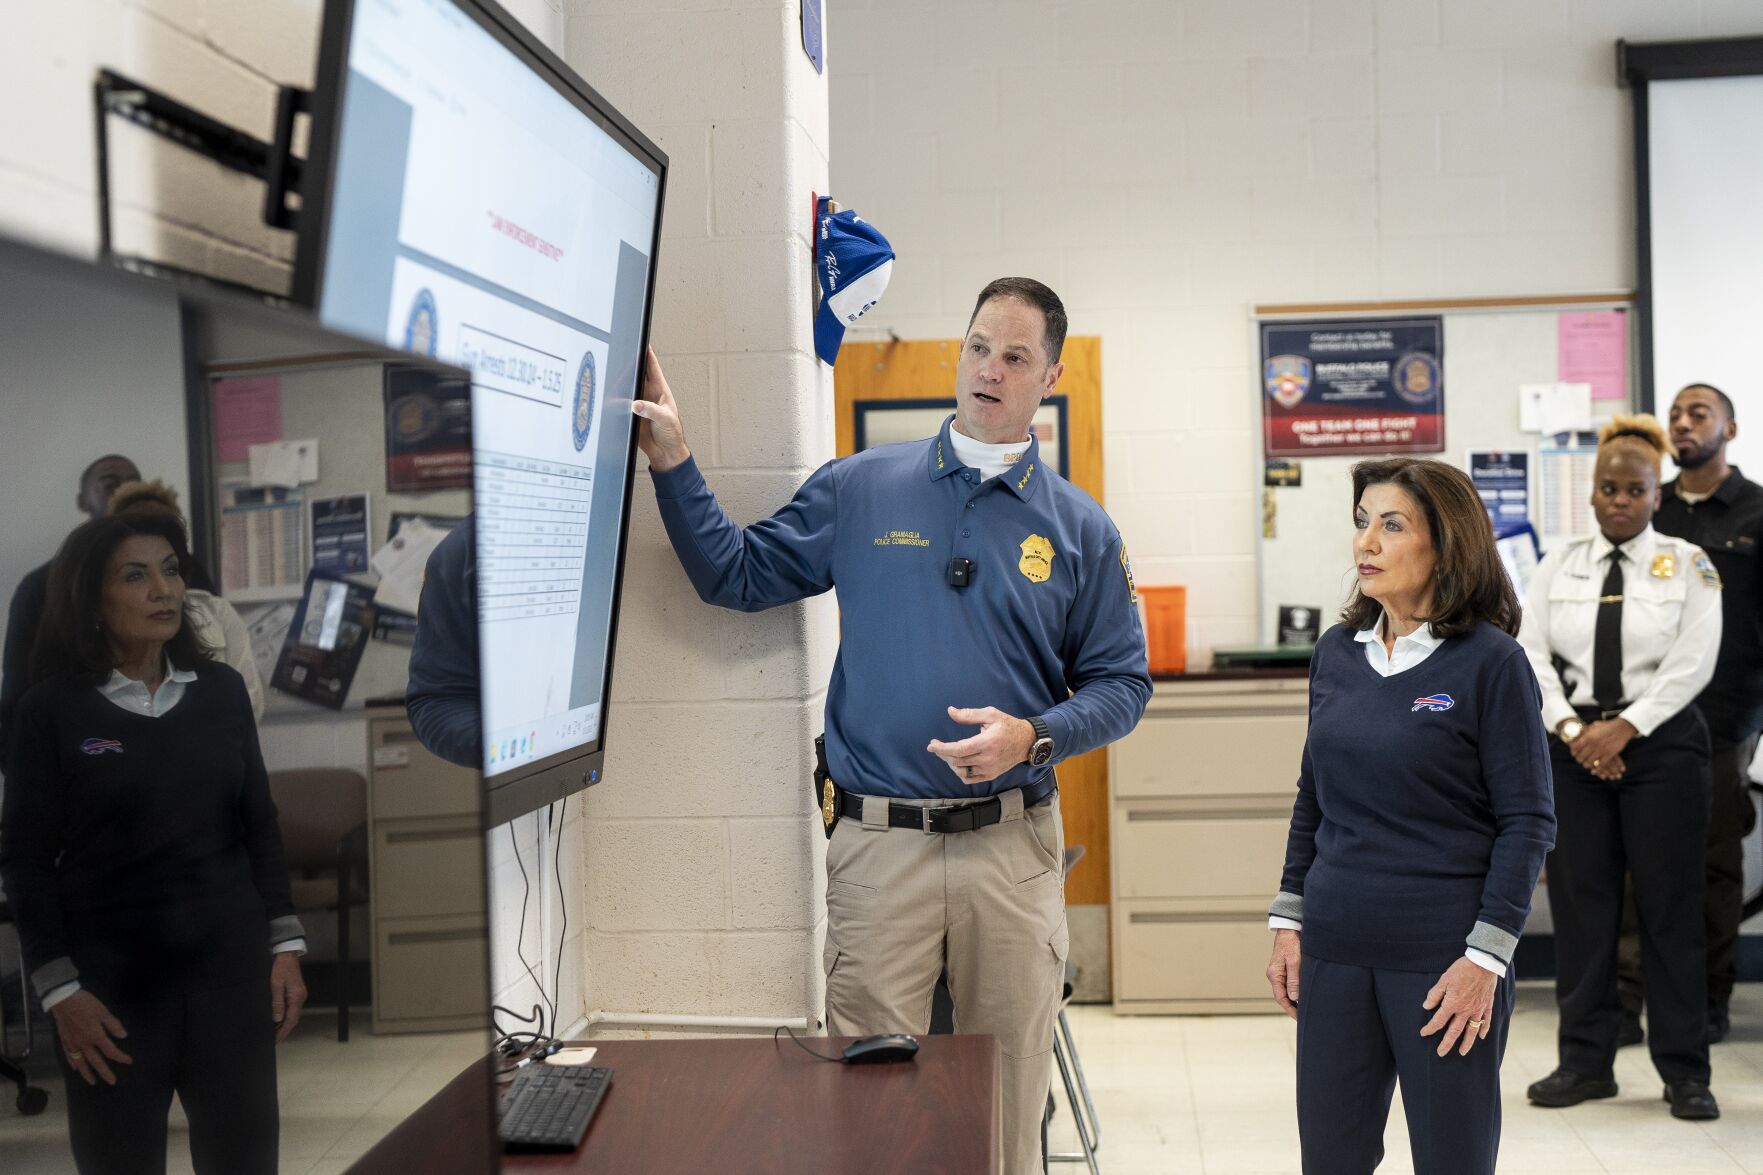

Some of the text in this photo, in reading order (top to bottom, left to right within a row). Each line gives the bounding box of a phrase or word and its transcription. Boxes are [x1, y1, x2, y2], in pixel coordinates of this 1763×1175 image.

[1292, 417, 1417, 433] ONE TEAM ONE FIGHT
[1299, 432, 1345, 445] Together
[1346, 433, 1361, 443] we
[1362, 432, 1382, 442] can
[1383, 431, 1398, 442] do
[889, 530, 920, 539] GRAMAGLIA
[873, 538, 930, 547] POLICE COMMISSIONER
